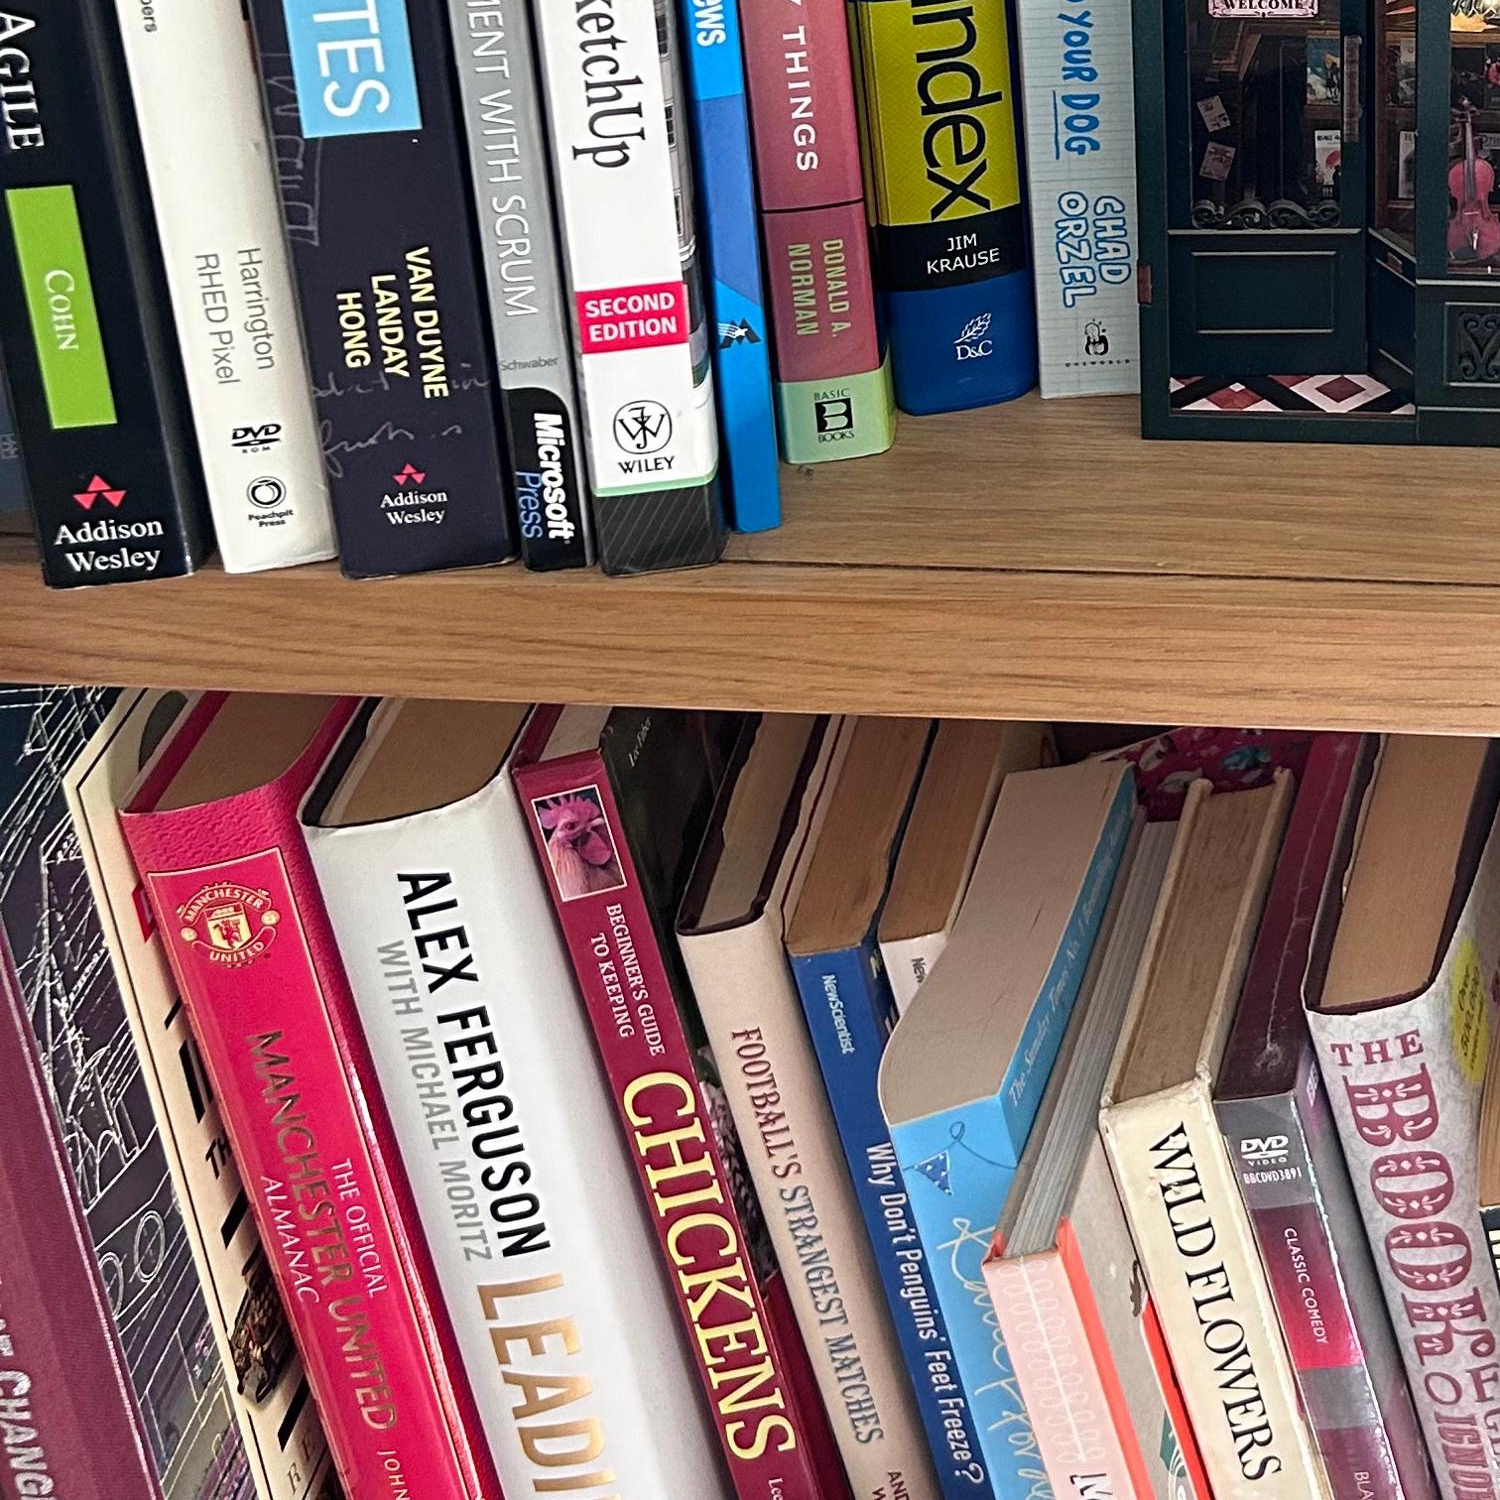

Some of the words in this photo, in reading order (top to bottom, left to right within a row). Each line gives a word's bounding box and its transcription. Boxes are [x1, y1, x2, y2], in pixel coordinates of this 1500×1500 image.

[0, 11, 45, 150] AGILE
[1058, 6, 1095, 84] YOUR
[479, 88, 521, 185] WITH
[782, 25, 820, 173] THINGS
[1064, 91, 1100, 157] DOG
[404, 246, 437, 303] VAN
[491, 194, 539, 318] SCRUM
[821, 237, 849, 313] DONALD
[926, 247, 1000, 275] KRAUSE
[946, 233, 979, 253] JIM
[1055, 190, 1097, 308] ORZEL
[1093, 195, 1131, 285] CHAD
[195, 253, 230, 326] RHED
[237, 246, 275, 371] Harrington
[370, 273, 412, 379] LANDAY
[585, 291, 676, 318] SECOND
[786, 243, 820, 337] NORMAN
[208, 329, 241, 386] Pixel
[336, 290, 372, 369] HONG
[413, 308, 451, 399] DUYNE
[499, 355, 560, 373] Schwaber
[588, 316, 678, 344] EDITION
[955, 338, 994, 359] D&C
[813, 388, 851, 400] BASIC
[618, 455, 676, 475] WILEY
[816, 428, 856, 443] BOOKS
[380, 488, 449, 509] Addison
[515, 469, 543, 540] Press
[533, 411, 577, 544] Microsoft
[54, 518, 165, 546] Addison
[386, 507, 447, 527] Wesley
[65, 546, 162, 574] Wesley
[183, 885, 269, 925] MANCHESTER
[396, 871, 480, 994] ALEX
[209, 938, 266, 963] UNITED
[590, 932, 609, 959] TO
[606, 902, 650, 1001] BEGINNER'S
[636, 1000, 667, 1058] GUIDE
[597, 960, 636, 1039] KEEPING
[1331, 1027, 1425, 1068] THE
[377, 939, 425, 1017] WITH
[402, 1026, 460, 1151] MICHAEL
[438, 1160, 494, 1262] MORITZ
[437, 1004, 552, 1260] FERGUSON
[866, 1141, 896, 1187] Why
[246, 1029, 357, 1287] MANCHESTER
[327, 1296, 398, 1431] UNITED
[260, 1174, 320, 1304] ALMANAC
[330, 1158, 360, 1201] THE
[345, 1204, 388, 1299] OFFICIAL
[730, 1025, 802, 1180] FOOTBALL'S
[779, 1184, 849, 1330] STRANGEST
[824, 1334, 885, 1446] MATCHES
[879, 1189, 914, 1245] Don't
[1342, 1062, 1499, 1367] BOOK
[622, 1070, 797, 1461] CHICKENS
[896, 1238, 948, 1344] Penguins'
[1148, 1121, 1218, 1259] WILD
[1185, 1260, 1283, 1484] FLOWERS
[1282, 1227, 1311, 1287] CLASSIC
[1300, 1286, 1331, 1347] COMEDY
[924, 1349, 958, 1394] Feet
